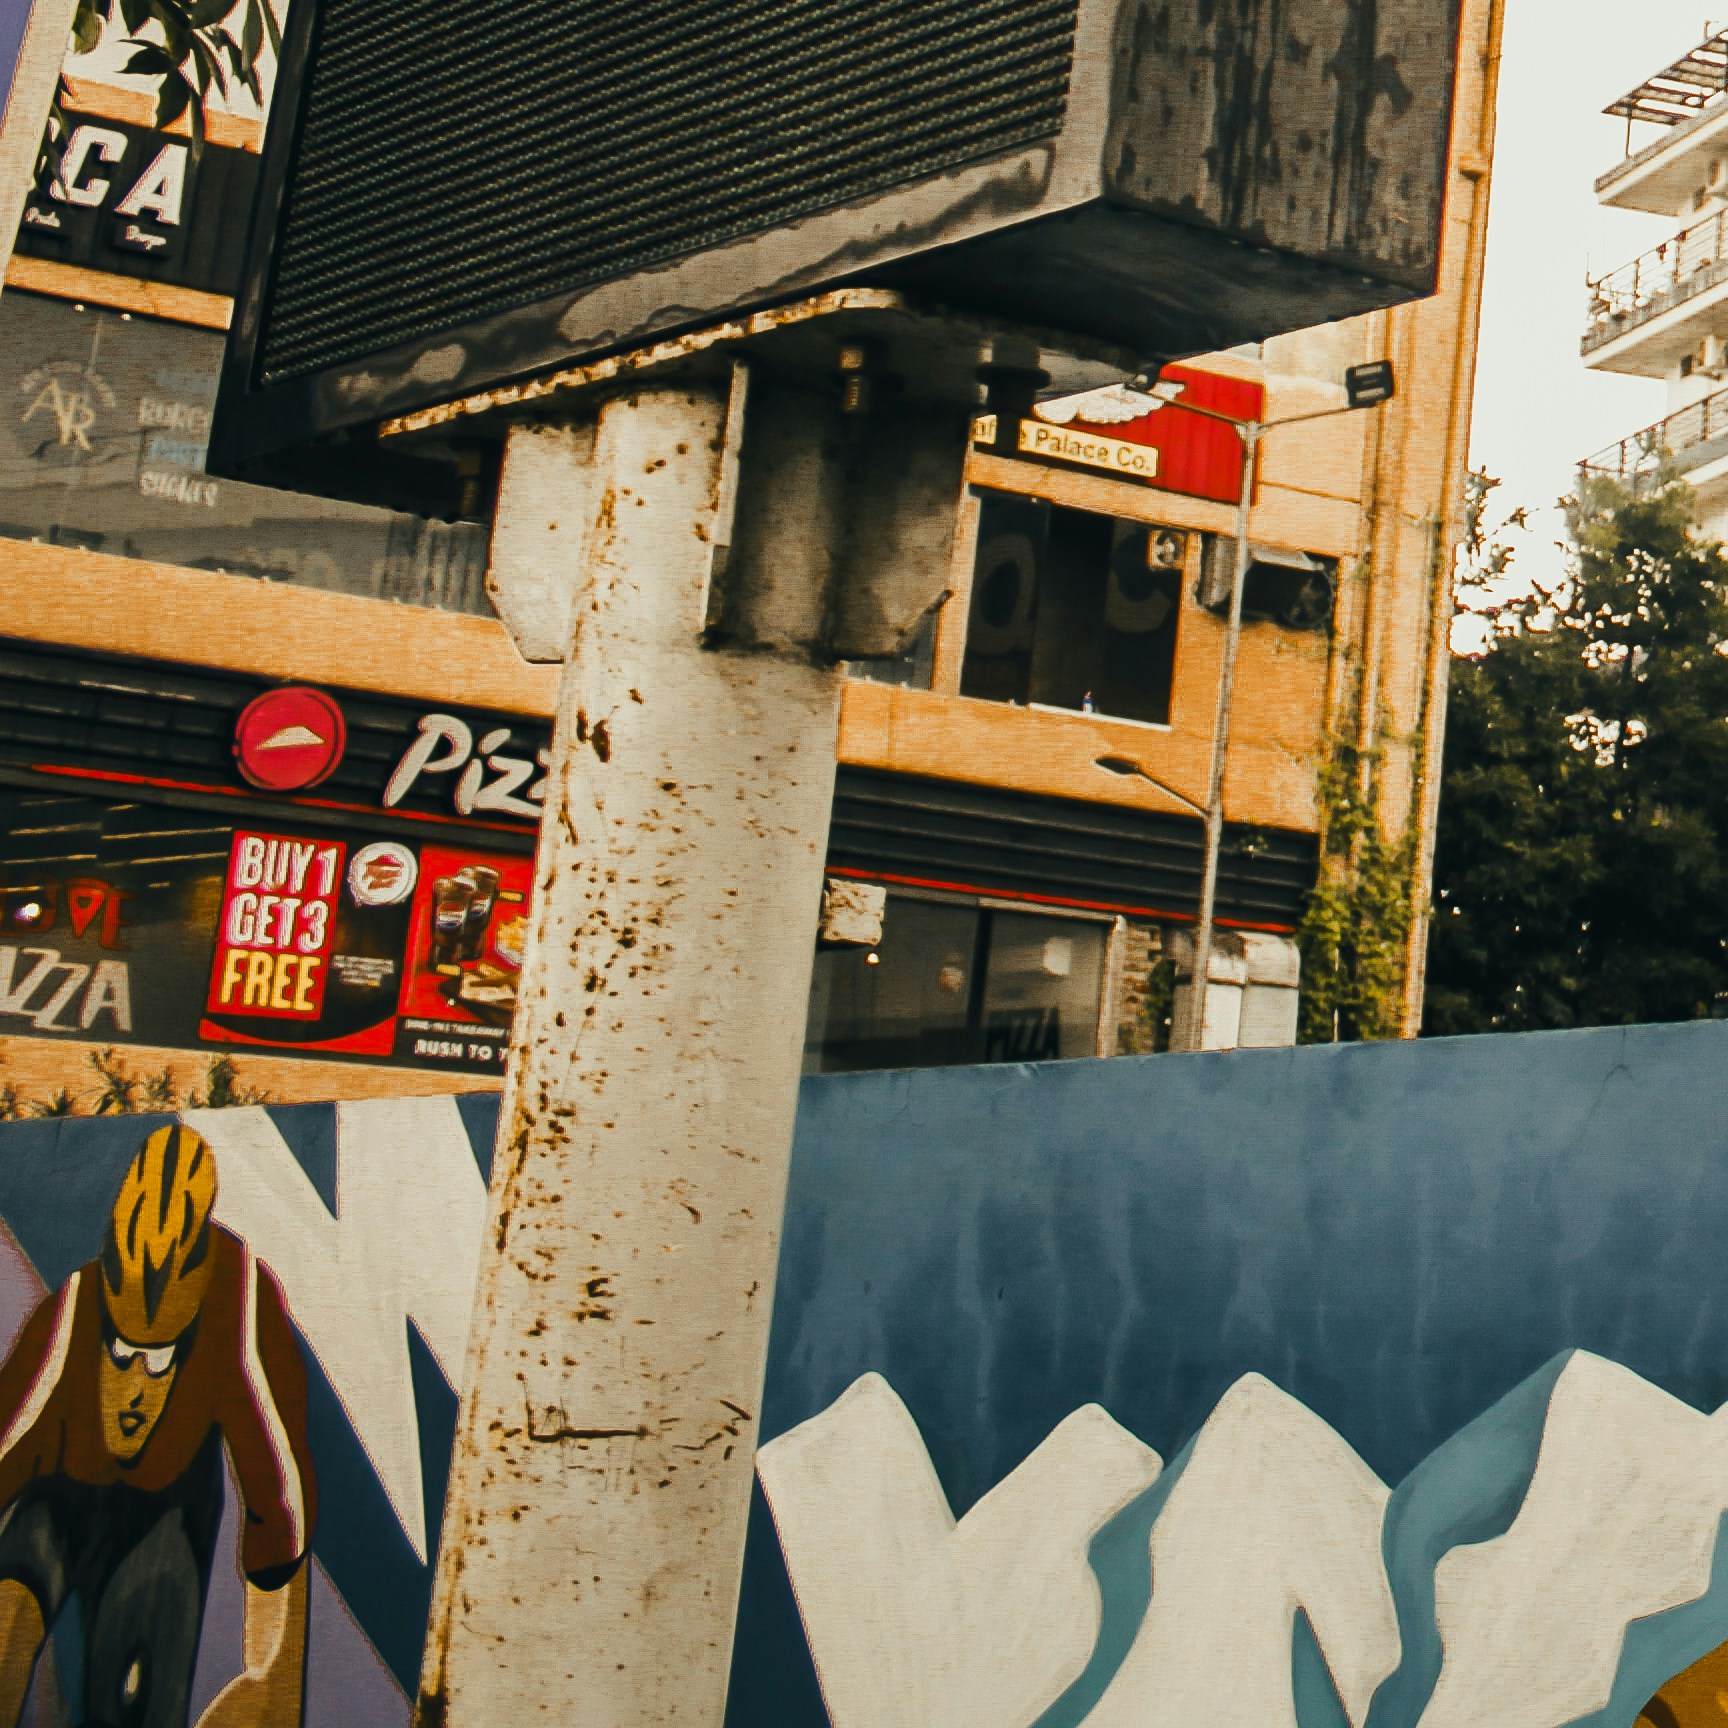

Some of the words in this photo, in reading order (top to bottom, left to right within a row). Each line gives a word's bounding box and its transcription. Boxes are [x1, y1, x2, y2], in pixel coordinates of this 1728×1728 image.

[38, 117, 188, 225] CA
[1035, 427, 1109, 464] Palace
[1116, 446, 1151, 472] Co.
[235, 836, 317, 894] BUY
[316, 847, 340, 896] 1
[0, 876, 134, 952] OVE
[228, 892, 302, 949] GET
[298, 899, 330, 953] 3
[219, 948, 322, 1011] FREE
[413, 1038, 464, 1059] RUSH
[468, 1044, 493, 1062] TO
